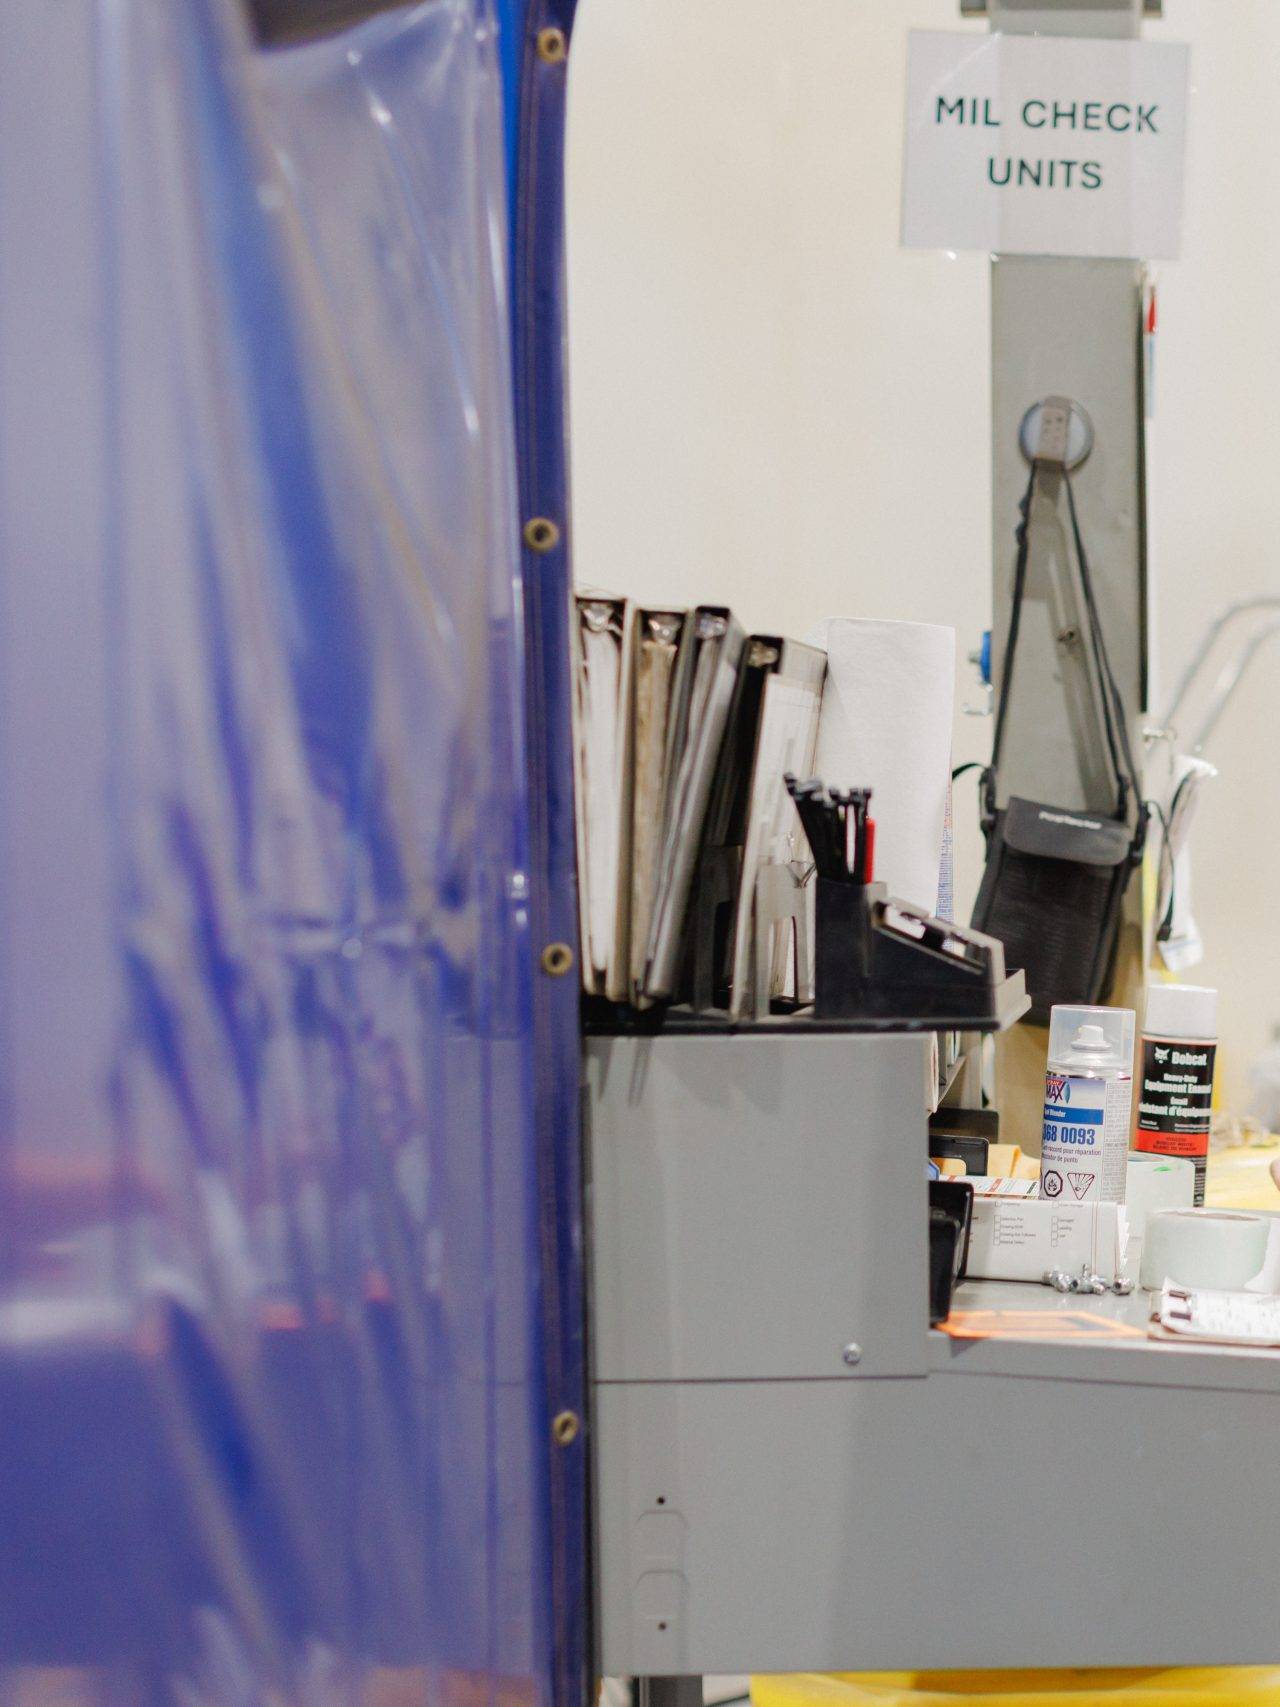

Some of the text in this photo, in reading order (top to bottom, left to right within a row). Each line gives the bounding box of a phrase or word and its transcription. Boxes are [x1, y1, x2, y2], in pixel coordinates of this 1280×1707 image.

[936, 97, 1159, 132] MIL CHECK
[988, 158, 1102, 189] UNITS
[1171, 1051, 1207, 1066] Bobcat
[1061, 1127, 1096, 1146] 0093
